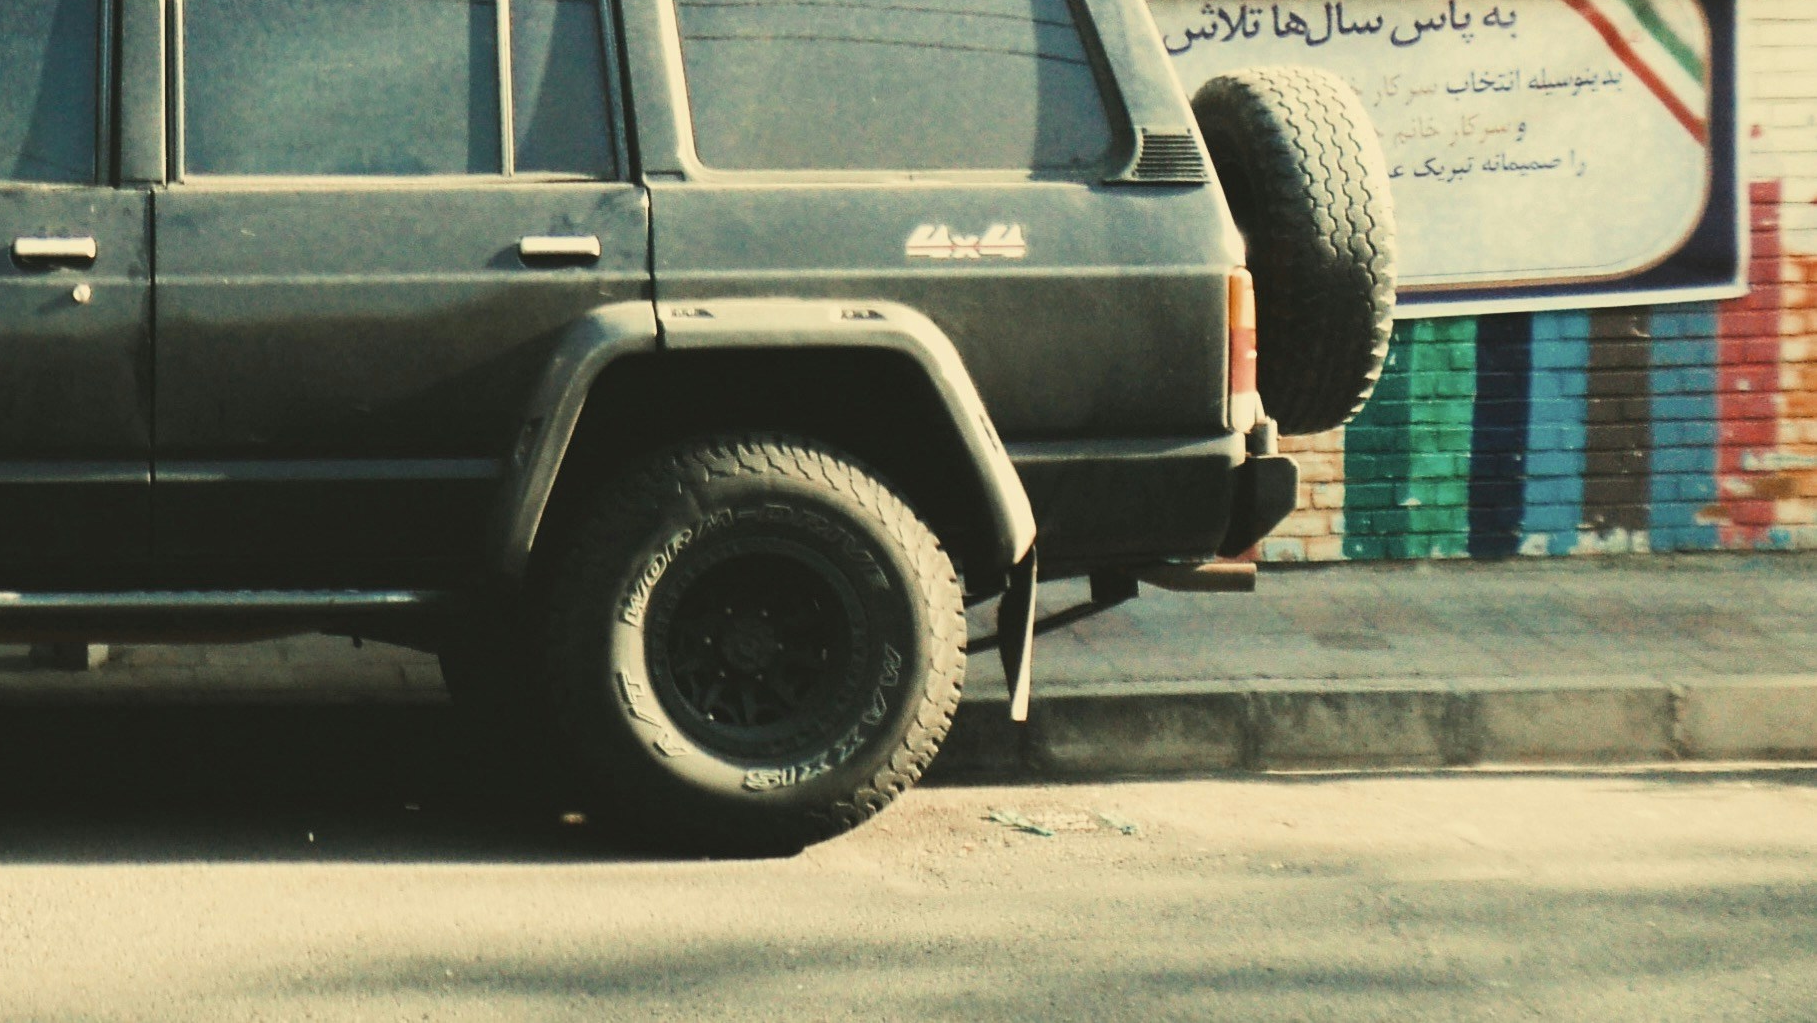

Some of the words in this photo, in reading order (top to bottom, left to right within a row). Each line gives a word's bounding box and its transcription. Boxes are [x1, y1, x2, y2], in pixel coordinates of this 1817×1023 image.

[1162, 2, 1265, 56] تلاش
[1482, 4, 1518, 39] به
[1372, 72, 1438, 108] سرکار
[1445, 68, 1521, 101] انتخاب
[1393, 116, 1441, 146] خانم
[1448, 113, 1510, 148] سرکار
[1515, 120, 1527, 142] و
[1412, 155, 1475, 183] تبریک
[1481, 152, 1562, 177] صمیمانه
[1568, 148, 1588, 177] را
